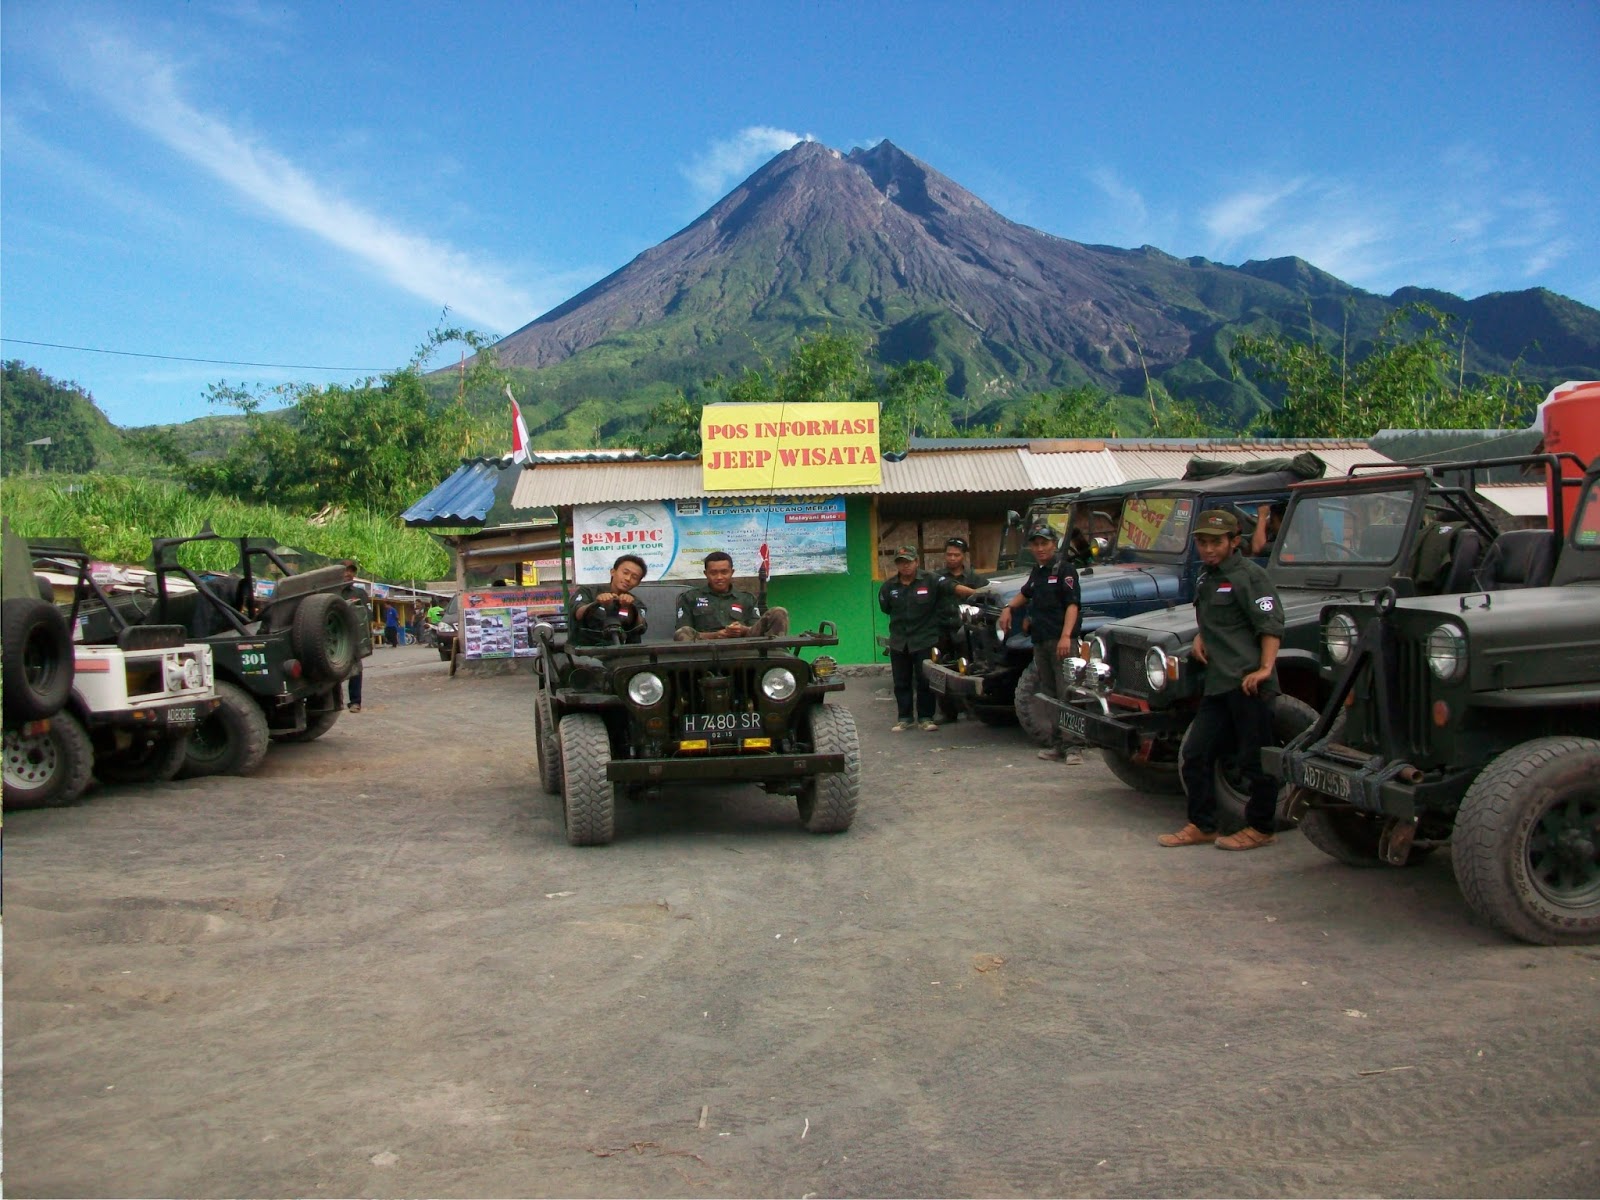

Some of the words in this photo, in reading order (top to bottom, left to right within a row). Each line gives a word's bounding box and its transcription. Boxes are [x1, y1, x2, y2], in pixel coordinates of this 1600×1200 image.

[708, 423, 749, 440] POS
[754, 418, 875, 438] INFORMASI
[707, 449, 772, 470] JEEP
[777, 445, 877, 467] WISATA
[617, 543, 637, 551] JEEP
[241, 653, 267, 665] 301
[685, 716, 695, 731] H
[701, 713, 736, 731] 7480
[741, 712, 761, 728] SR
